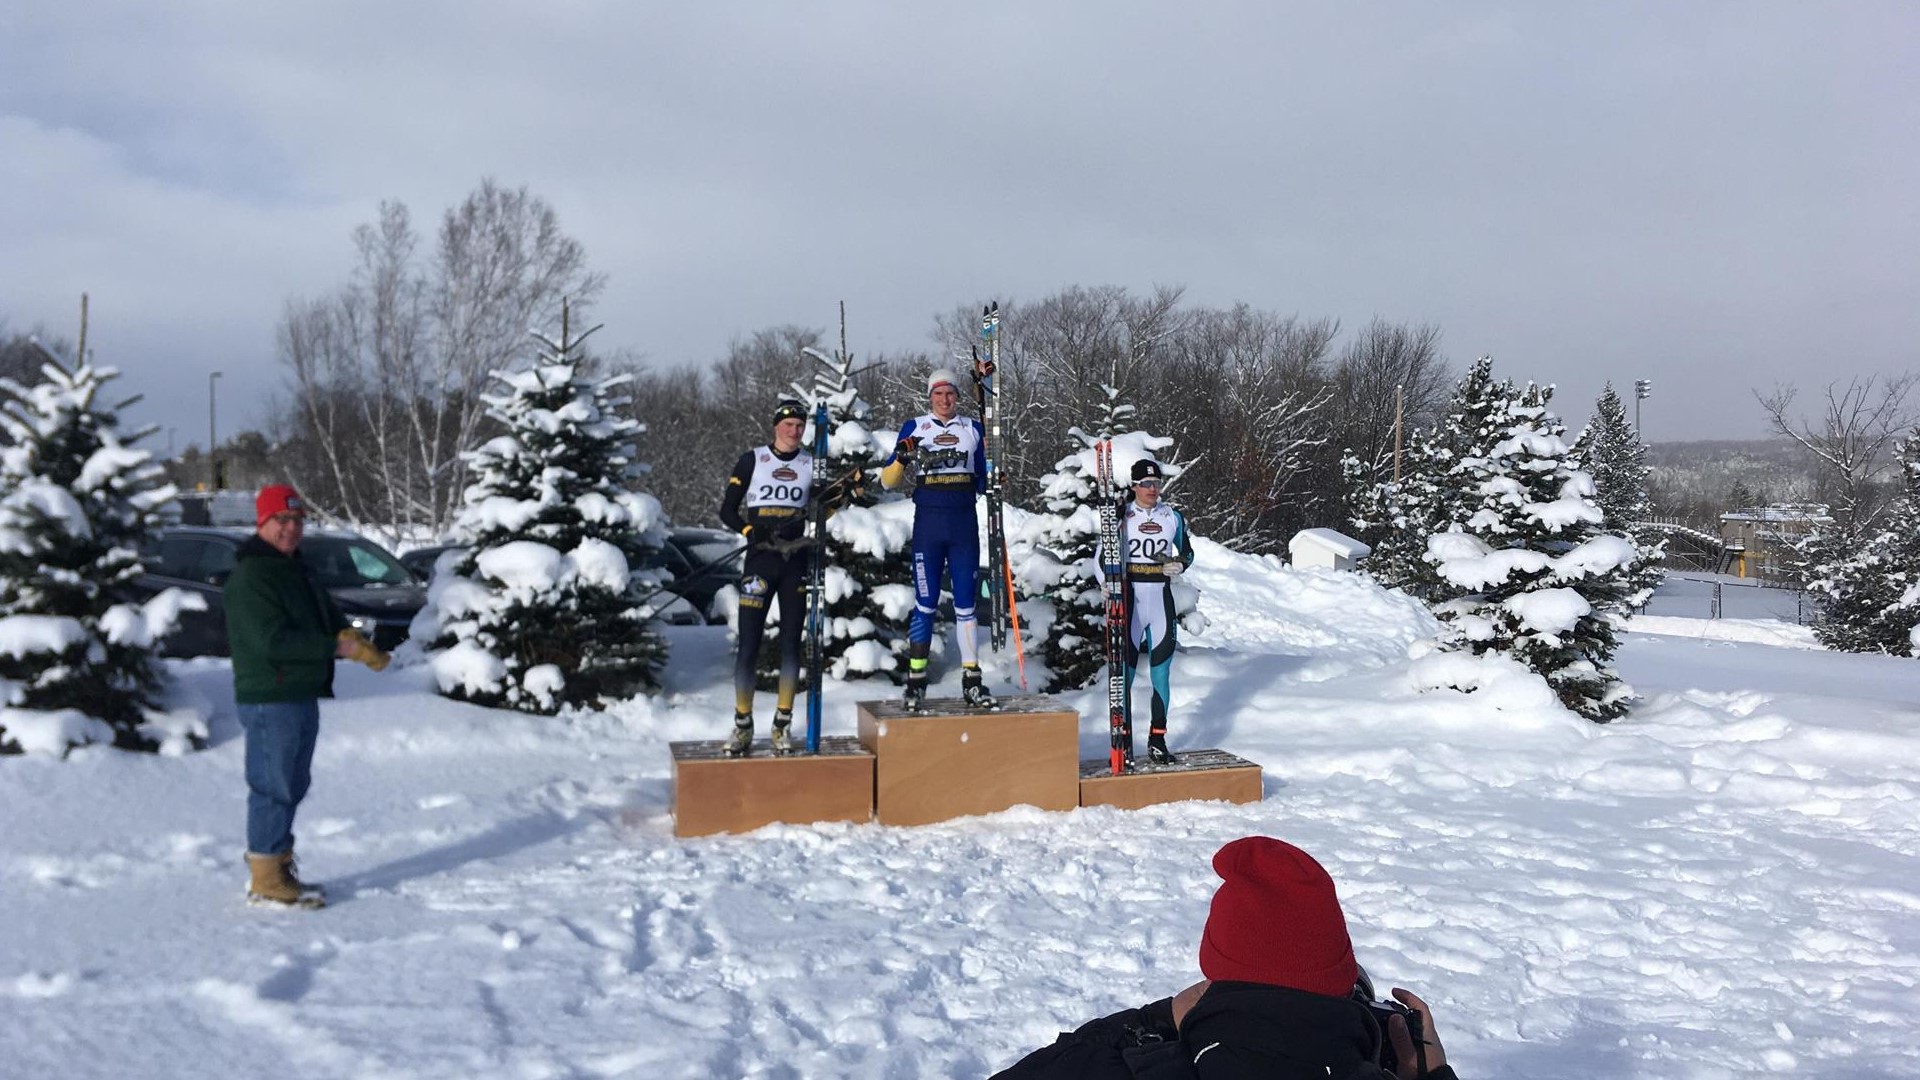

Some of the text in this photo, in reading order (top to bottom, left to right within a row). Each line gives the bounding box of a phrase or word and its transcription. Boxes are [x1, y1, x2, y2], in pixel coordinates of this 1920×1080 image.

[760, 484, 803, 502] 200
[1101, 503, 1112, 565] ROSSIGNOL
[1108, 502, 1121, 565] ROSSIGNOL
[1129, 538, 1168, 558] 202
